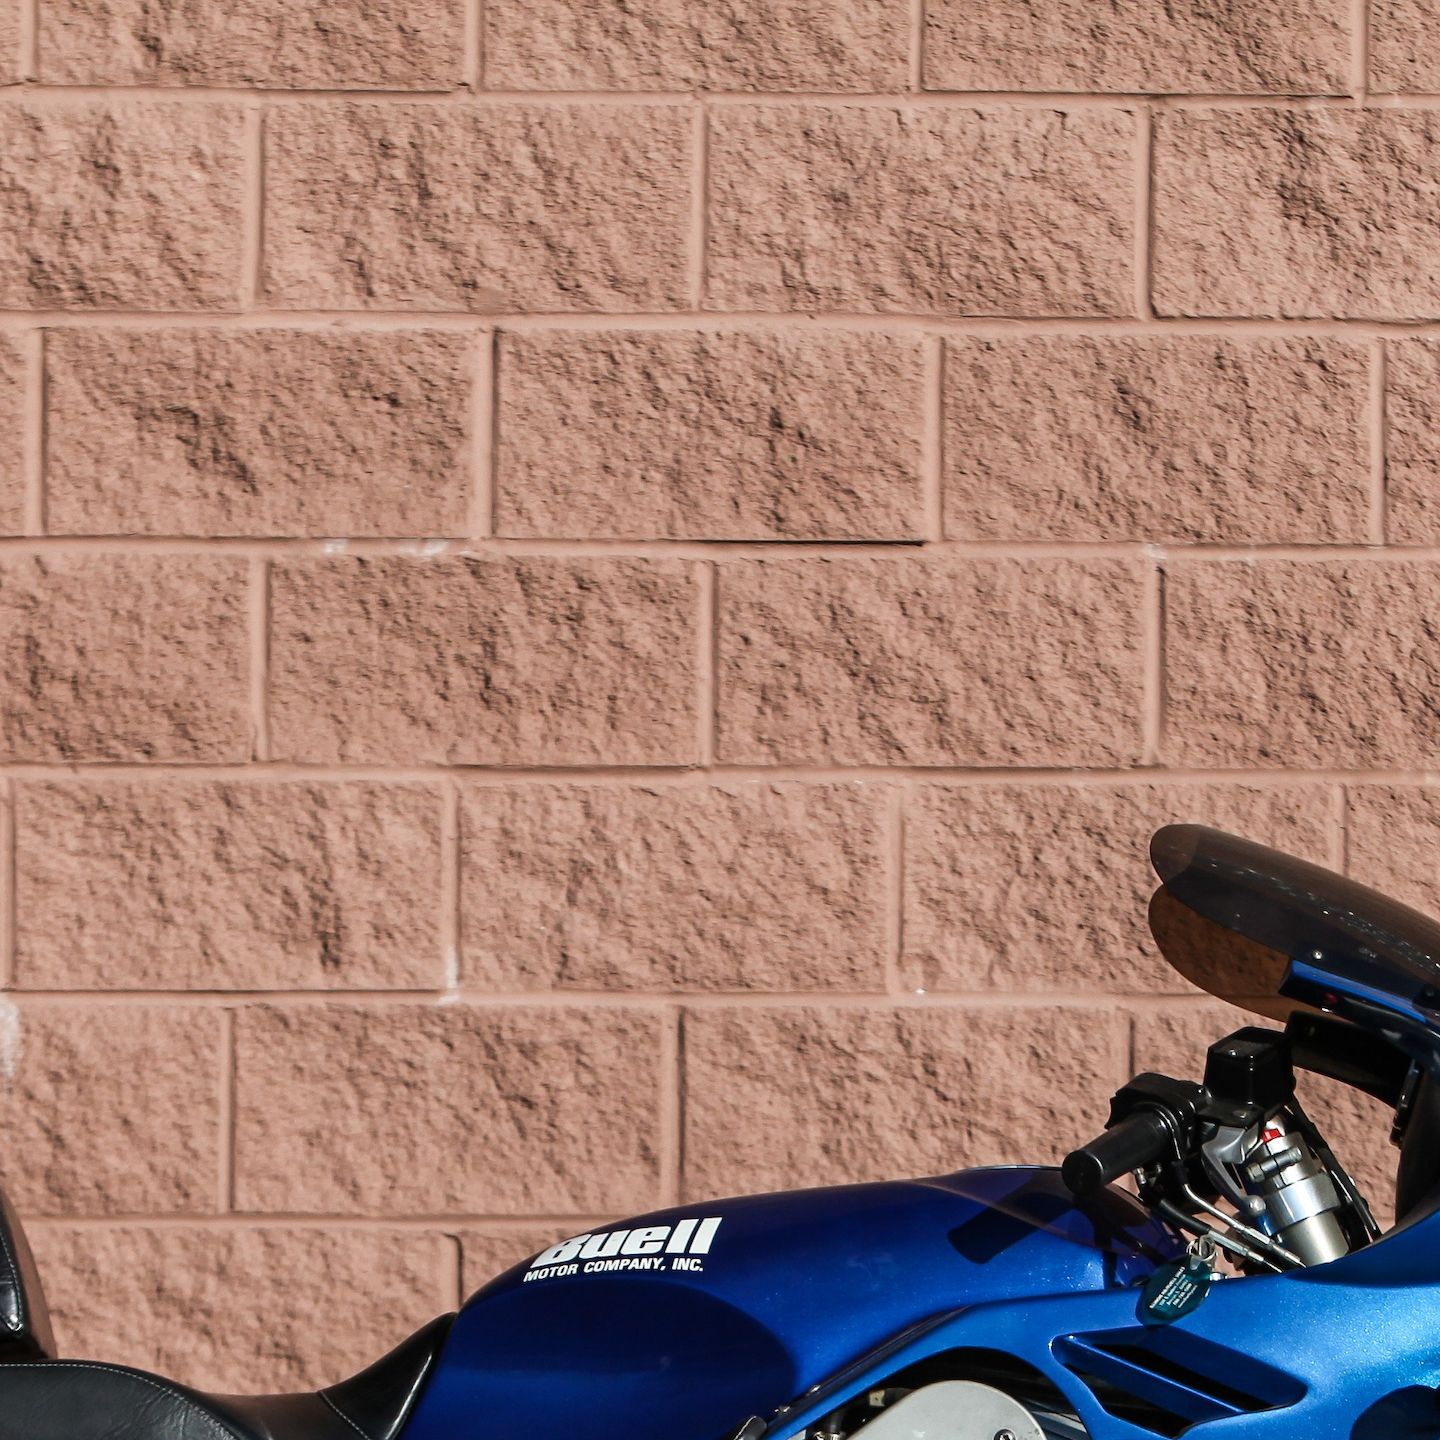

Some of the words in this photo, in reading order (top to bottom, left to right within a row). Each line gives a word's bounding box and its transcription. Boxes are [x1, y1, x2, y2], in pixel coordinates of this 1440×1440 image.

[531, 1217, 722, 1267] Buell
[523, 1264, 578, 1282] MOTOR
[583, 1258, 665, 1273] COMPANY,
[672, 1258, 704, 1272] INC.
